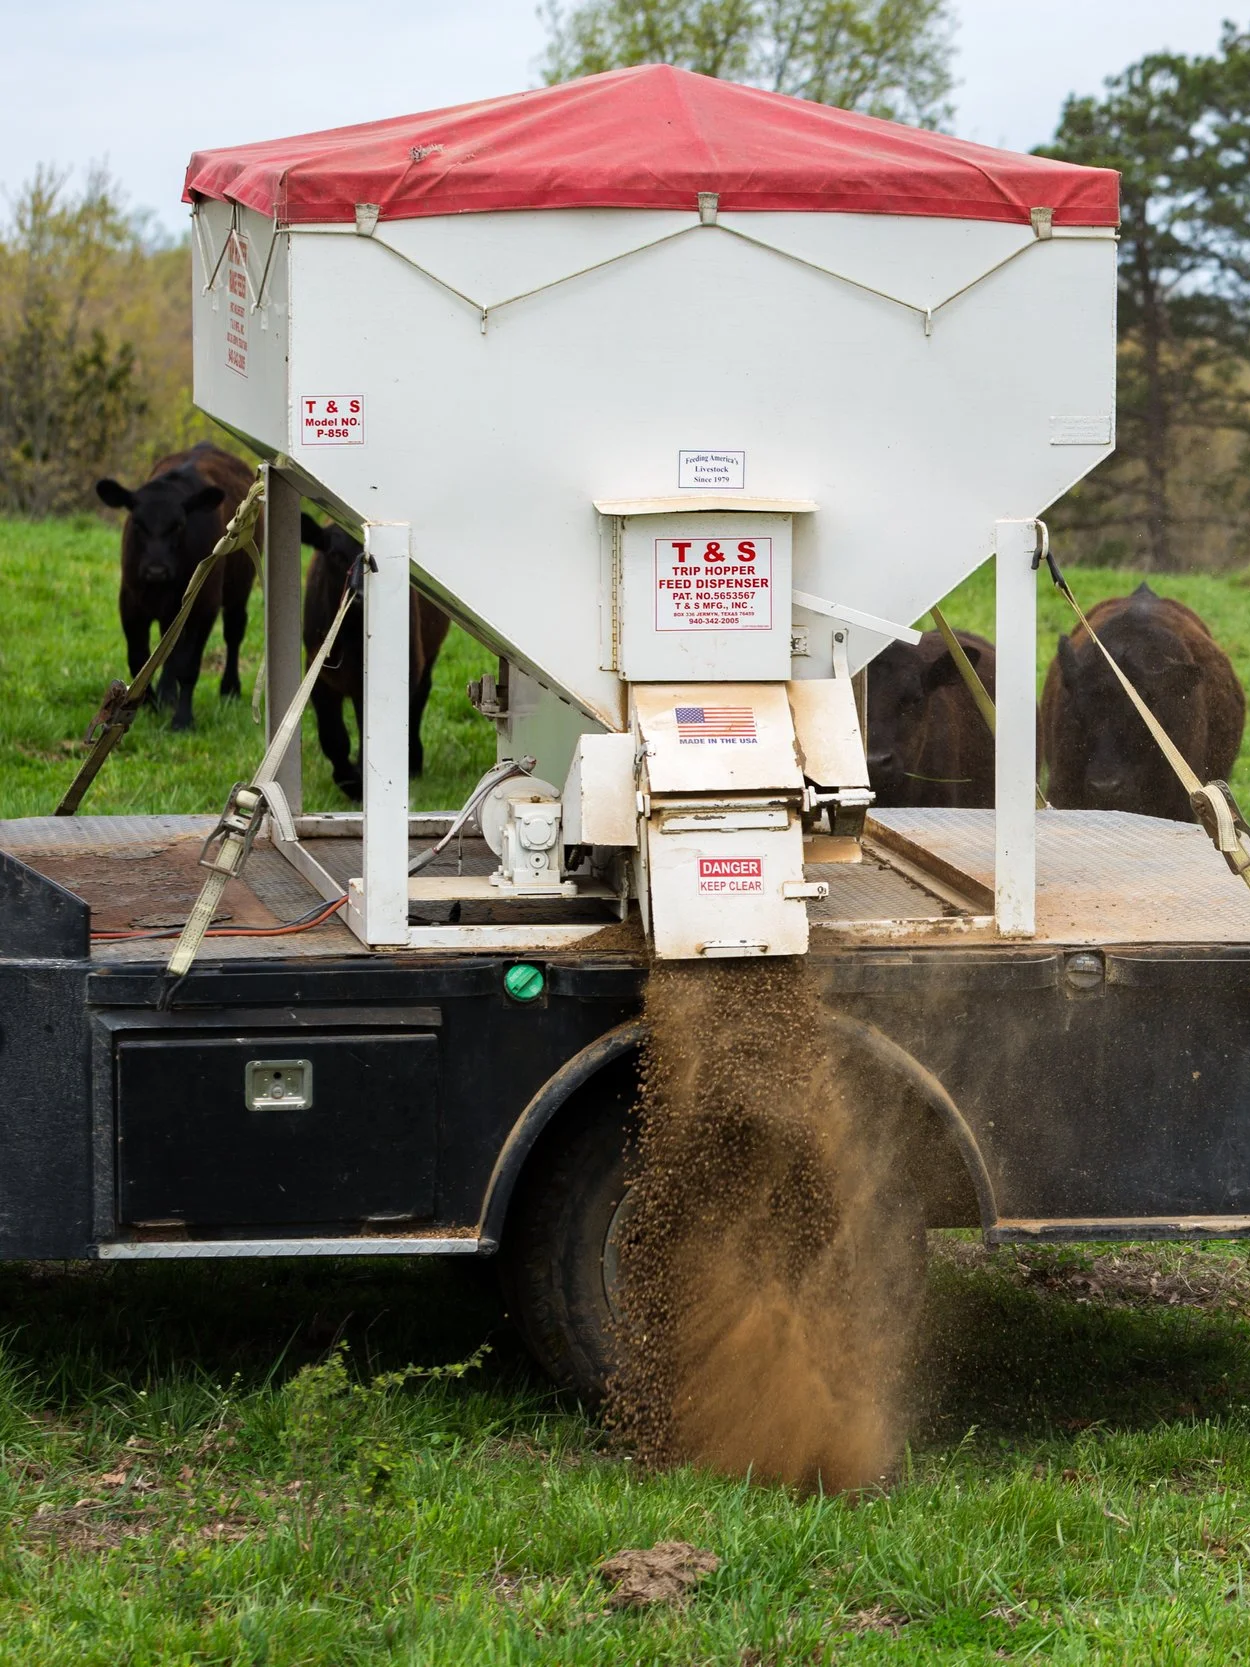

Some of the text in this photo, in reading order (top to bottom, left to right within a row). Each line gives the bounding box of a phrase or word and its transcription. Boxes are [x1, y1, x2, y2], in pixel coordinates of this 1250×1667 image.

[306, 400, 360, 413] T & S
[306, 417, 360, 426] Model NO.
[317, 429, 349, 437] P-856
[685, 455, 739, 465] Feeding America's
[672, 541, 756, 562] T & S
[672, 566, 755, 576] TRIP HOPPER
[659, 578, 769, 589] FEED DISPENSER
[672, 592, 756, 600] PAT. NO.5653567
[703, 861, 759, 874] DANGER
[700, 881, 762, 891] KEEP CLEAR
